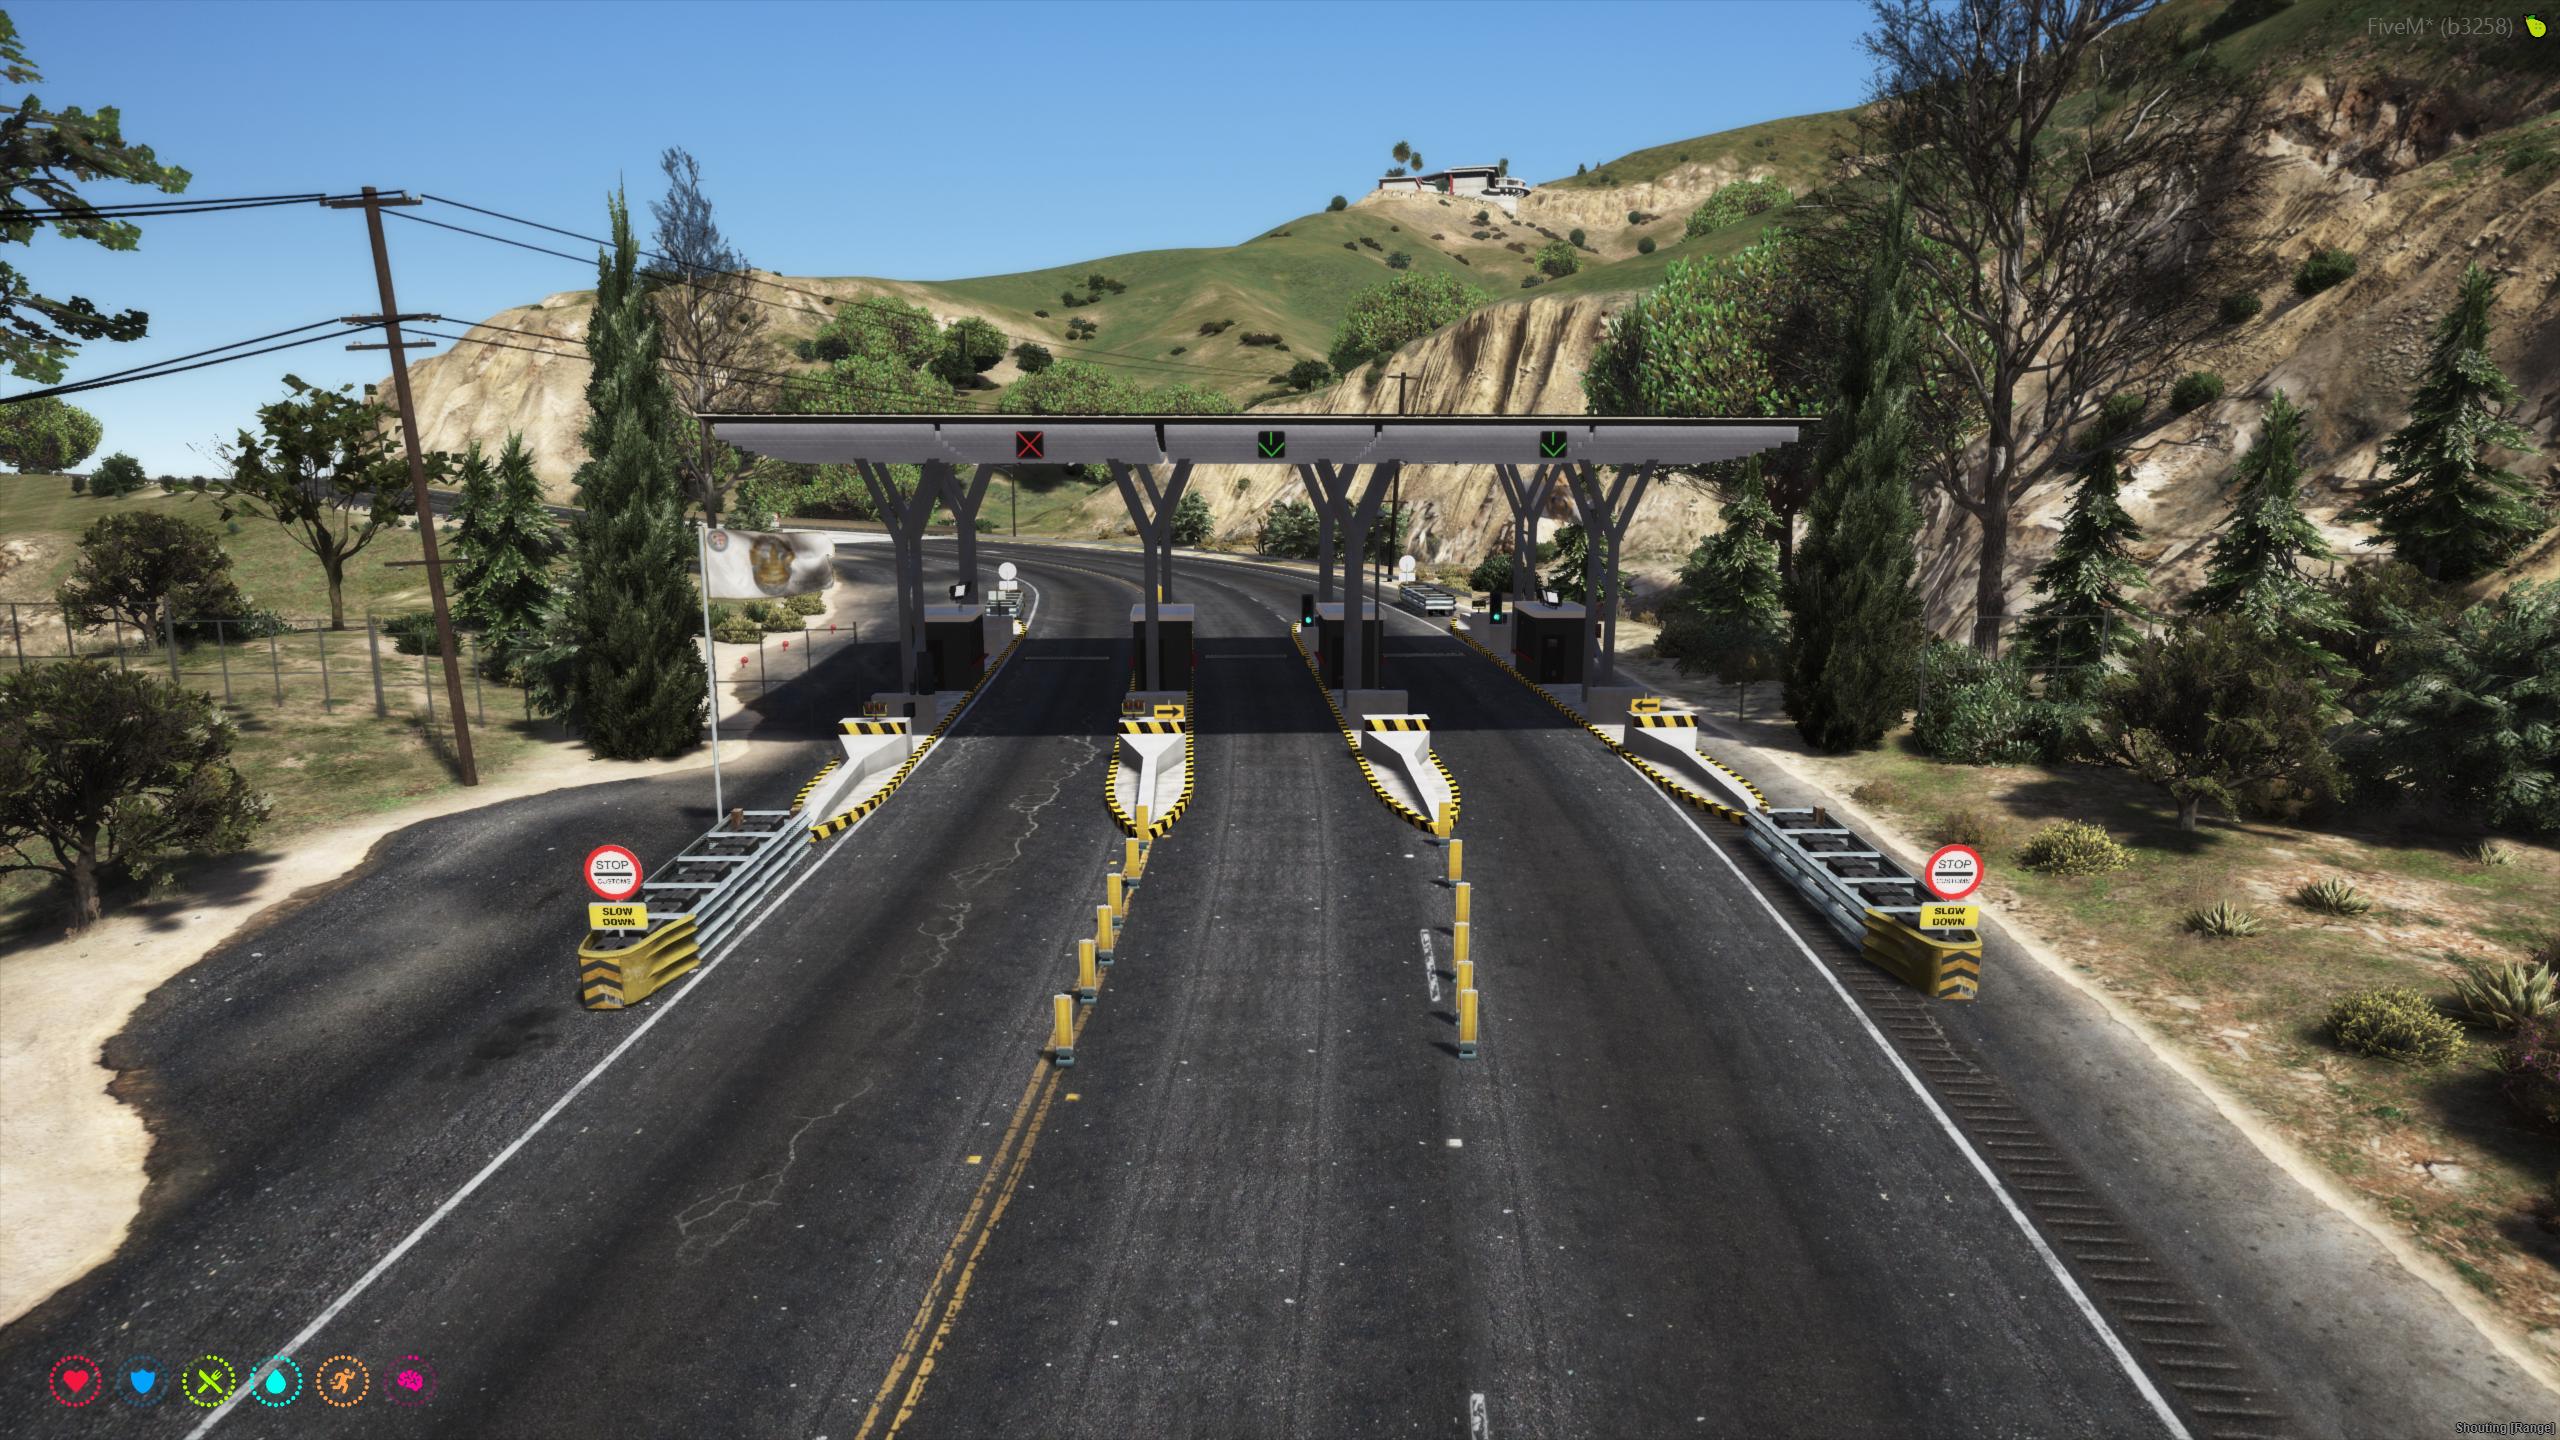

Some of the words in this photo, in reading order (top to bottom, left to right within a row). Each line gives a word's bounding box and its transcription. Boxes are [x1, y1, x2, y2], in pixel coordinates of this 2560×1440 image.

[596, 860, 629, 870] STOP
[1938, 859, 1972, 869] STOP
[603, 907, 632, 915] SLOW
[1934, 907, 1966, 915] SLOW
[603, 918, 635, 926] DOWN
[1932, 918, 1966, 926] DOWN
